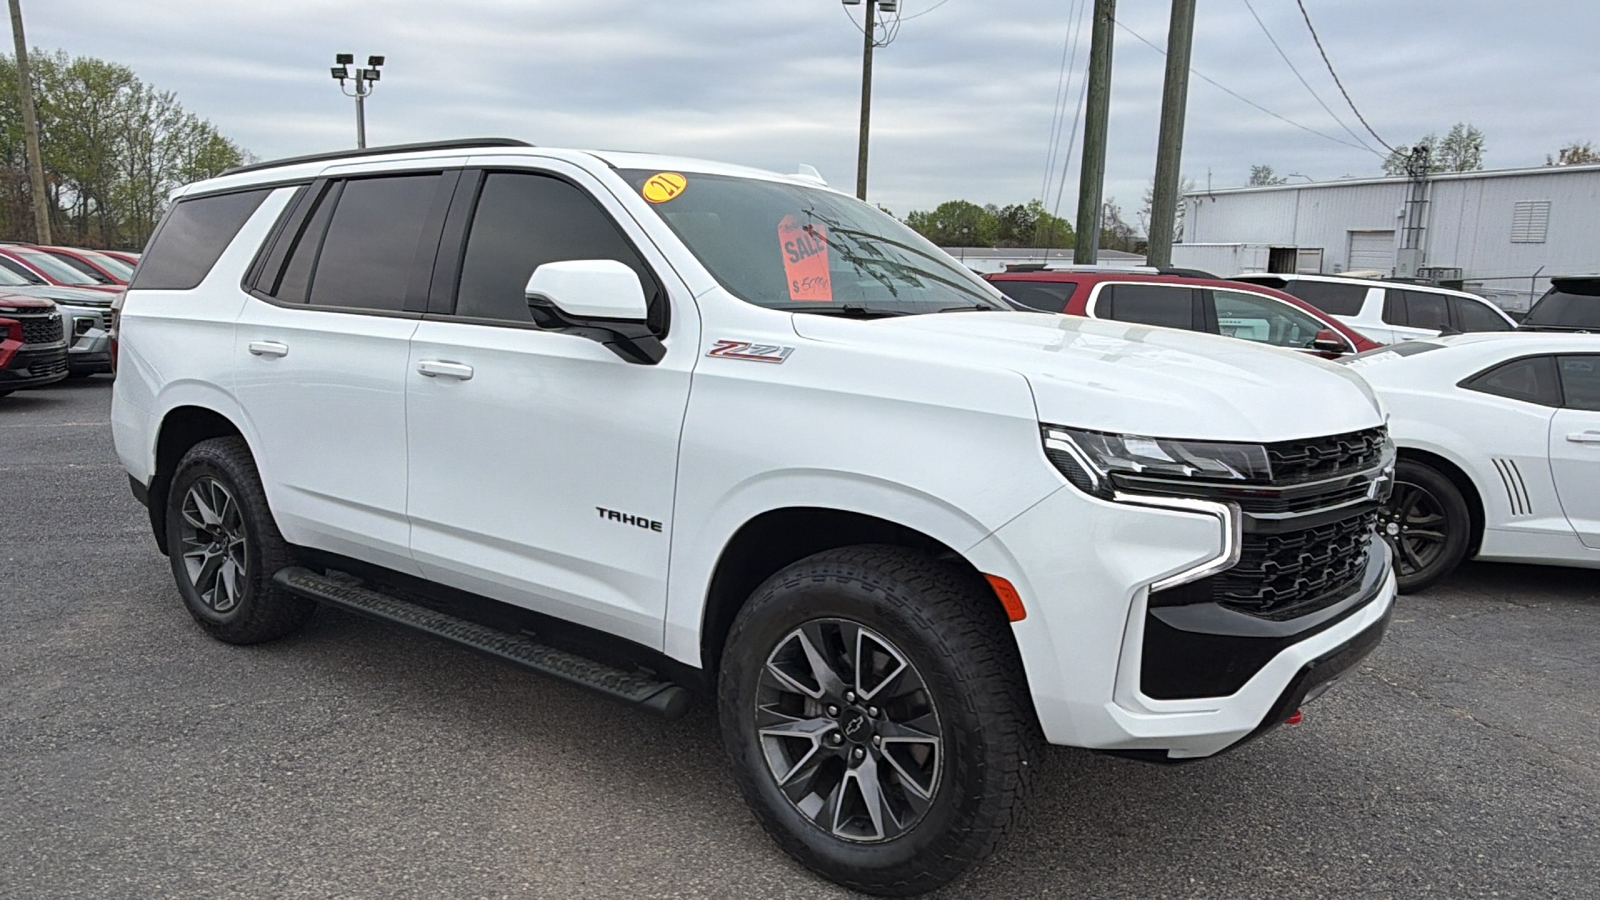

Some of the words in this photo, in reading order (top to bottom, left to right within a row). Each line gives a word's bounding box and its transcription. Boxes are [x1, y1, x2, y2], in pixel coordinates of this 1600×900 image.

[650, 175, 681, 197] 21
[785, 233, 824, 263] SALE
[707, 339, 795, 362] Z71
[595, 506, 663, 533] TAHOE
